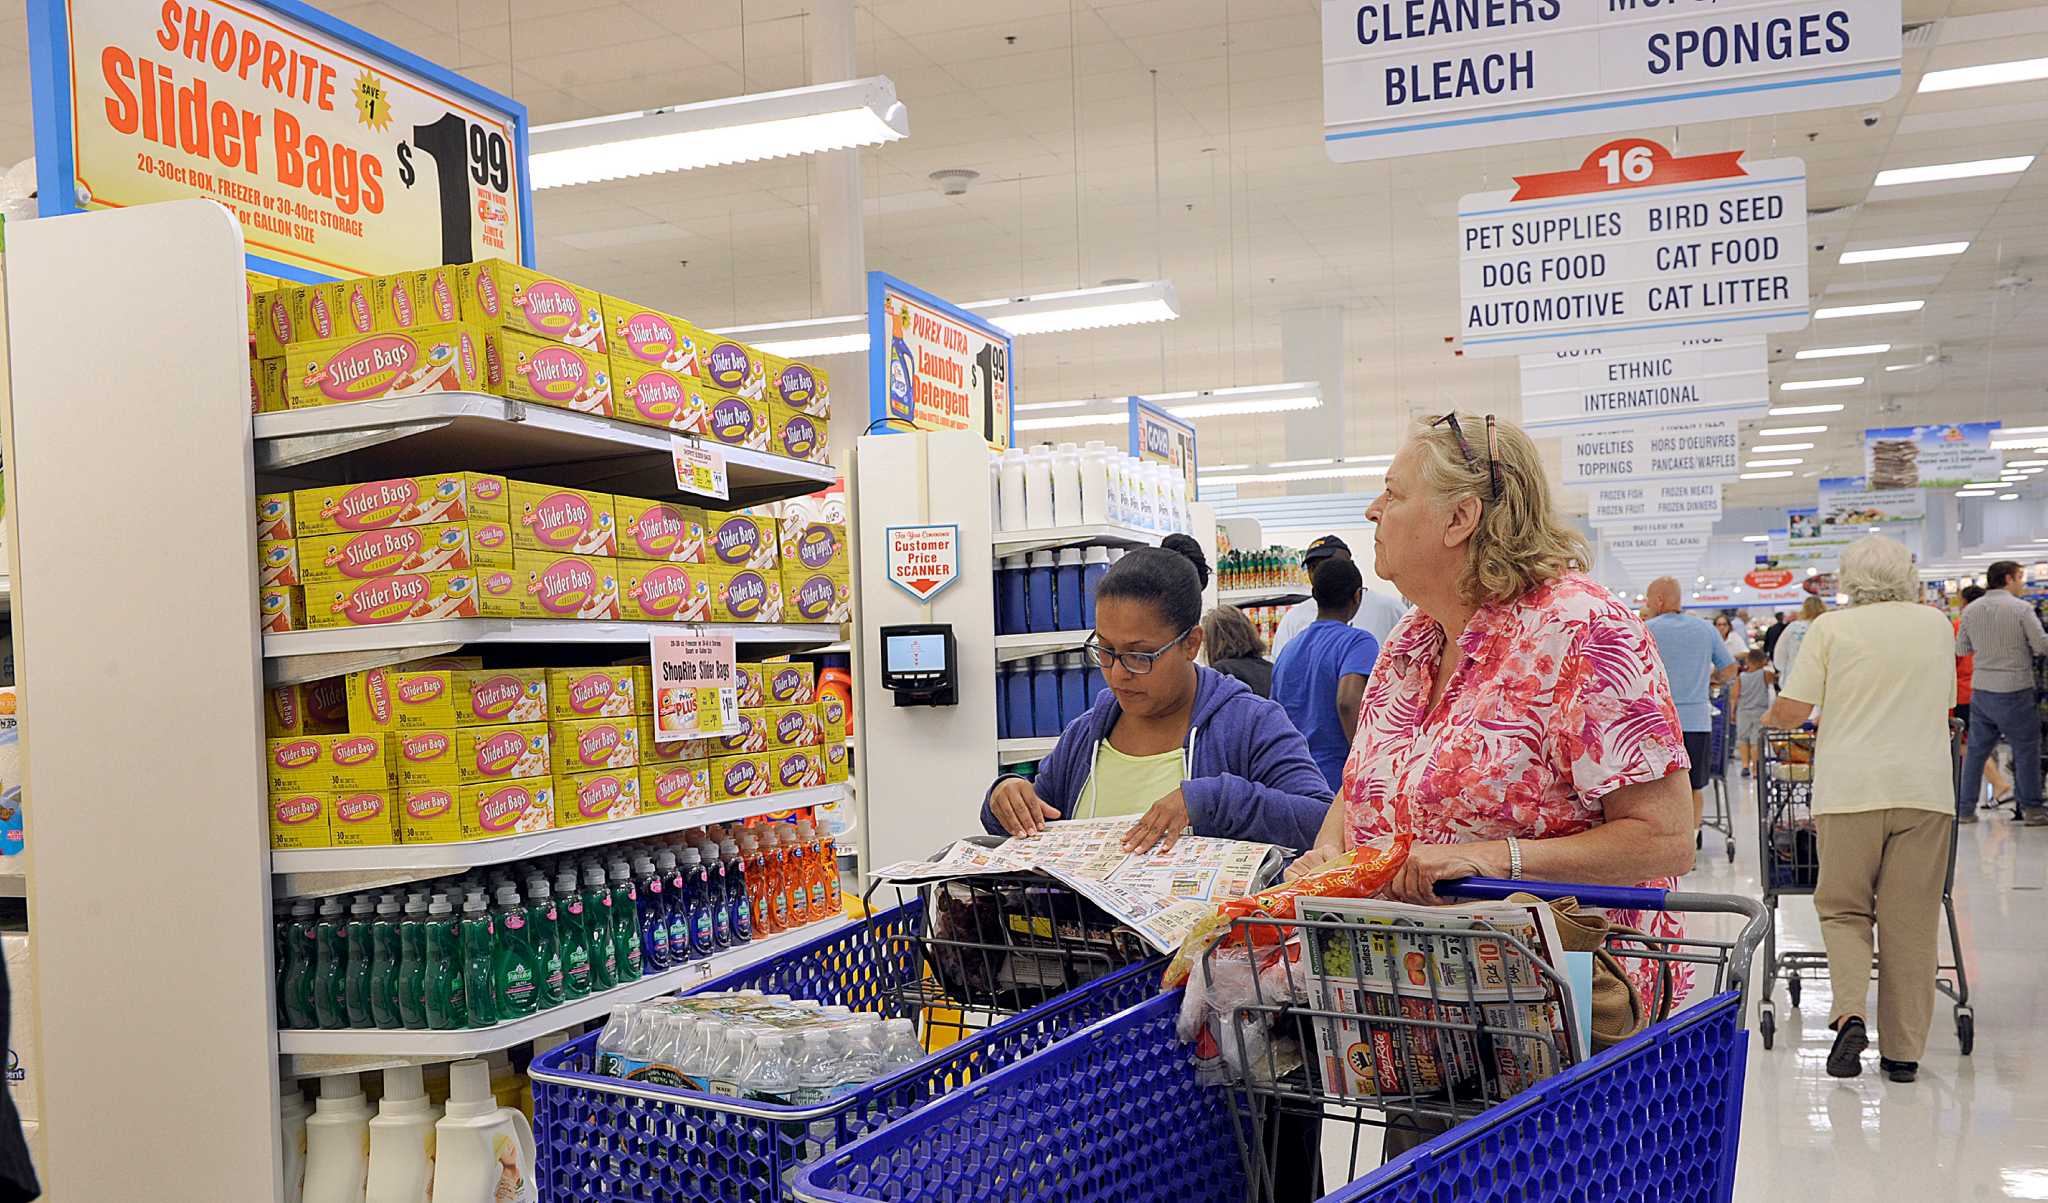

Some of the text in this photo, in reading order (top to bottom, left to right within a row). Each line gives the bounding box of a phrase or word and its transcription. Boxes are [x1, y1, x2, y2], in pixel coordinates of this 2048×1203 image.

[1356, 0, 1561, 46] CLEANERS
[1647, 10, 1851, 75] SPONGES
[157, 0, 336, 111] SHOPRITE
[1385, 49, 1534, 107] BLEACH
[361, 83, 380, 100] SAVE
[101, 46, 385, 215] Slider Bags
[1598, 146, 1655, 185] 16
[137, 153, 186, 184] 20-30ct
[189, 169, 216, 193] BOX,
[218, 178, 261, 205] FREEZER
[263, 194, 275, 211] or
[277, 197, 319, 225] 30-40ct
[319, 210, 363, 238] STORAGE
[1649, 194, 1784, 232] BIRD SEED
[239, 209, 315, 244] or GALLON SIZE
[1466, 211, 1622, 252] PET SUPPLIES
[1656, 235, 1779, 272] CAT FOOD
[1482, 253, 1606, 289] DOG FOOD
[528, 292, 577, 316] Slider Bags
[1648, 275, 1789, 312] CAT LITTER
[1468, 291, 1624, 328] AUTOMOTIVE
[629, 322, 673, 344] Slider Bags
[912, 312, 968, 356] PUREX ULTRA
[329, 343, 409, 387] Slider Bags
[532, 357, 583, 382] Slider Bags
[711, 352, 748, 373] Slider Bags
[918, 344, 964, 389] Laundry
[1608, 358, 1673, 381] ETHNIC
[637, 382, 681, 404] Slider Bags
[913, 373, 970, 419] Detergent
[1584, 384, 1700, 412] INTERNATIONAL
[714, 408, 751, 428] Slider Bags
[1147, 422, 1169, 456] GOYA
[1576, 439, 1634, 457] NOVELTIES
[1651, 438, 1677, 452] HORS
[1578, 460, 1633, 476] TOPPINGS
[342, 482, 412, 518] Slider Bags
[1599, 490, 1626, 501] FROZEN
[1661, 486, 1688, 498] FROZEN
[538, 503, 588, 530] Slider Bags
[1597, 505, 1623, 516] FROZEN
[1657, 501, 1684, 513] FROZEN
[640, 517, 681, 540] Slider Bags
[718, 525, 756, 550] Slider Bags
[346, 532, 416, 567] Slider Bags
[895, 540, 950, 552] Customer
[908, 553, 938, 564] Price
[543, 569, 592, 597] Slider Bags
[896, 564, 950, 577] SCANNER
[352, 578, 424, 613] Slider Bags
[643, 575, 687, 601] Slider Bags
[729, 581, 764, 605] Slider Bags
[800, 584, 832, 607] Slider Bags
[662, 660, 730, 683] ShopRite Slider Bags
[403, 680, 441, 698] Slider Bags
[477, 682, 519, 708] Slider Bags
[573, 680, 611, 704] Slider Bags
[675, 700, 698, 717] PLUS
[279, 745, 318, 762] Slider Bags
[337, 743, 375, 760] Slider Bags
[408, 738, 446, 756] Slider Bags
[481, 738, 523, 765] Slider Bags
[582, 731, 617, 756] Slider Bags
[727, 763, 755, 786] Slider Bags
[342, 799, 380, 816] Slider Bags
[411, 795, 449, 812] Slider Bags
[484, 794, 527, 821] Slider Bags
[582, 782, 618, 808] Slider Bags
[281, 800, 318, 817] Slider Bags
[1361, 944, 1374, 976] Seedless
[1478, 943, 1503, 985] Pick 10
[1373, 1033, 1399, 1089] ShopRite
